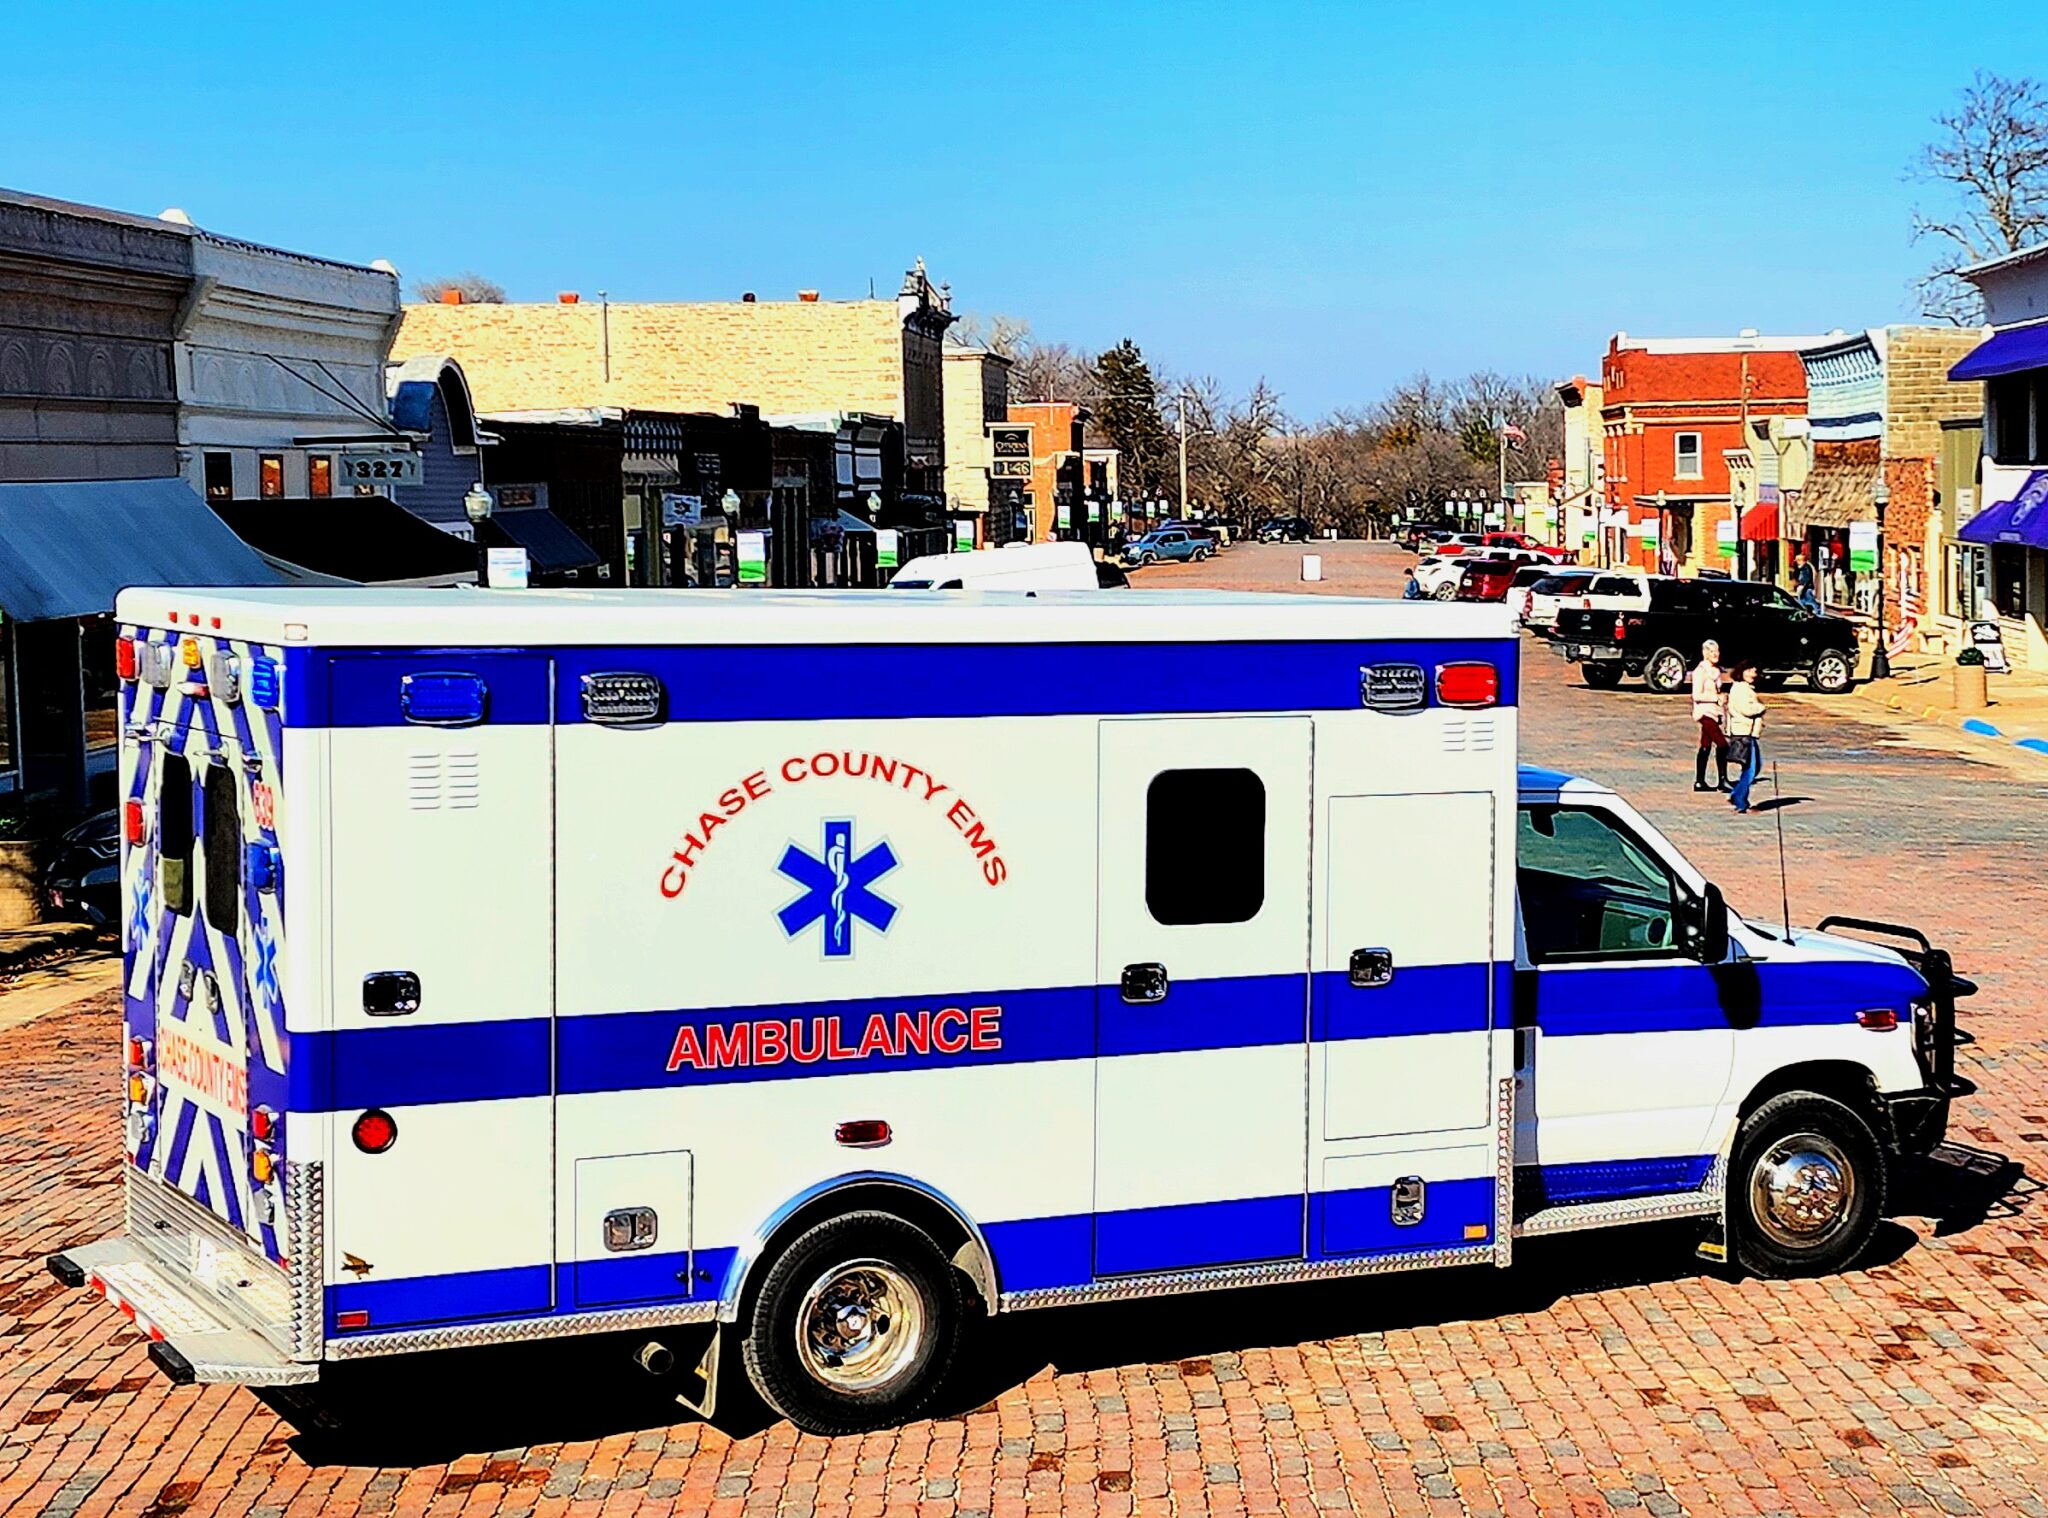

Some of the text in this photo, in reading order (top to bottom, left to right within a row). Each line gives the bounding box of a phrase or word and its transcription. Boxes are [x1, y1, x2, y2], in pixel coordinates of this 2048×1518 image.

[356, 460, 404, 478] 327
[659, 751, 1007, 900] CHASE COUNTY EMS
[159, 1026, 247, 1116] CHASE COUNTY EMS
[666, 1007, 1002, 1071] AMBULANCE
